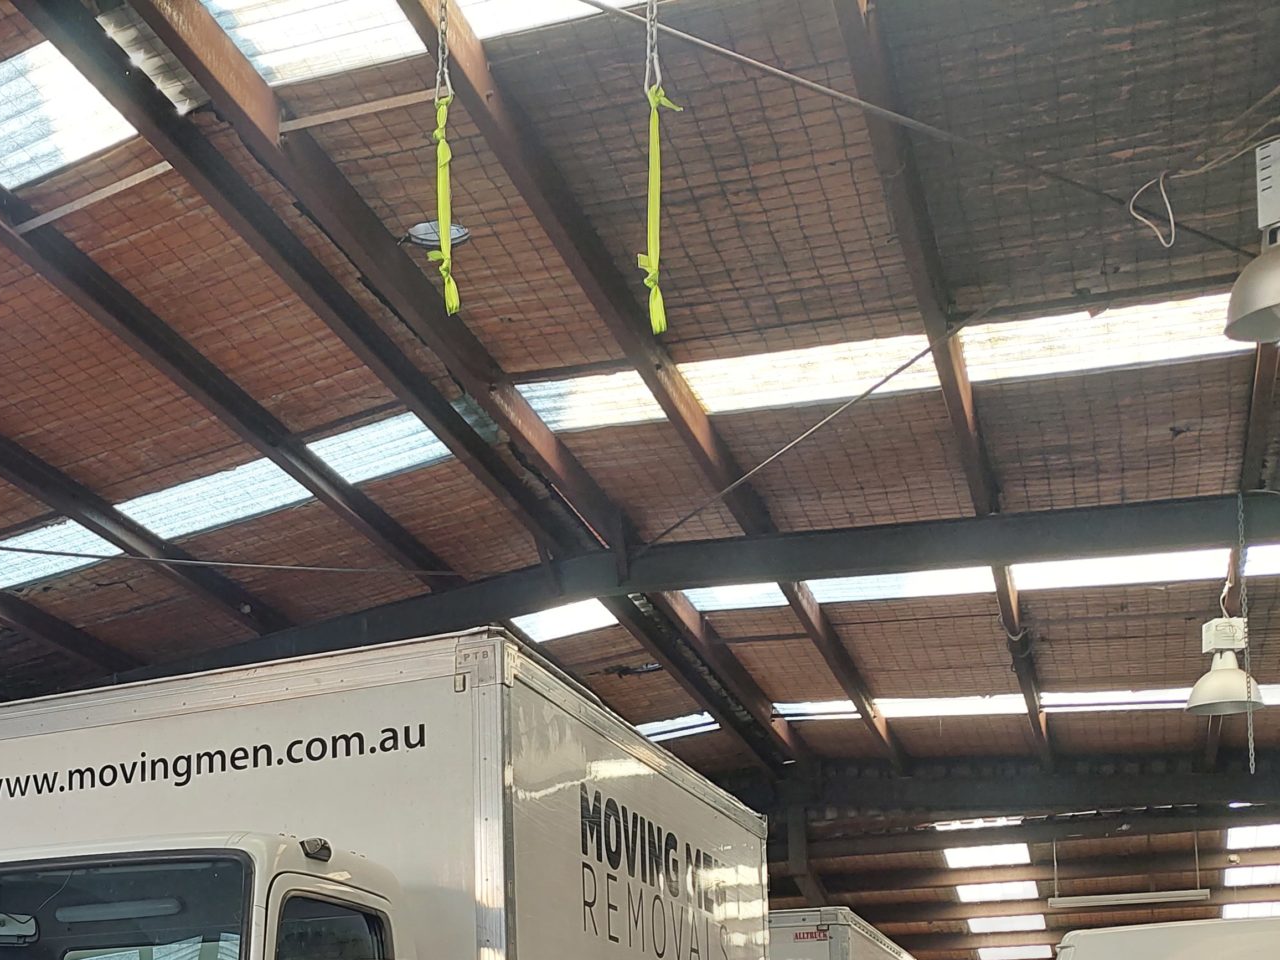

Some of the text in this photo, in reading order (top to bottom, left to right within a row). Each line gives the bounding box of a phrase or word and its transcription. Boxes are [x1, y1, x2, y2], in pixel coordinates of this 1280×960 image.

[463, 650, 489, 662] PTB
[580, 781, 680, 898] MOVING
[794, 931, 828, 941] ALLTRUCK
